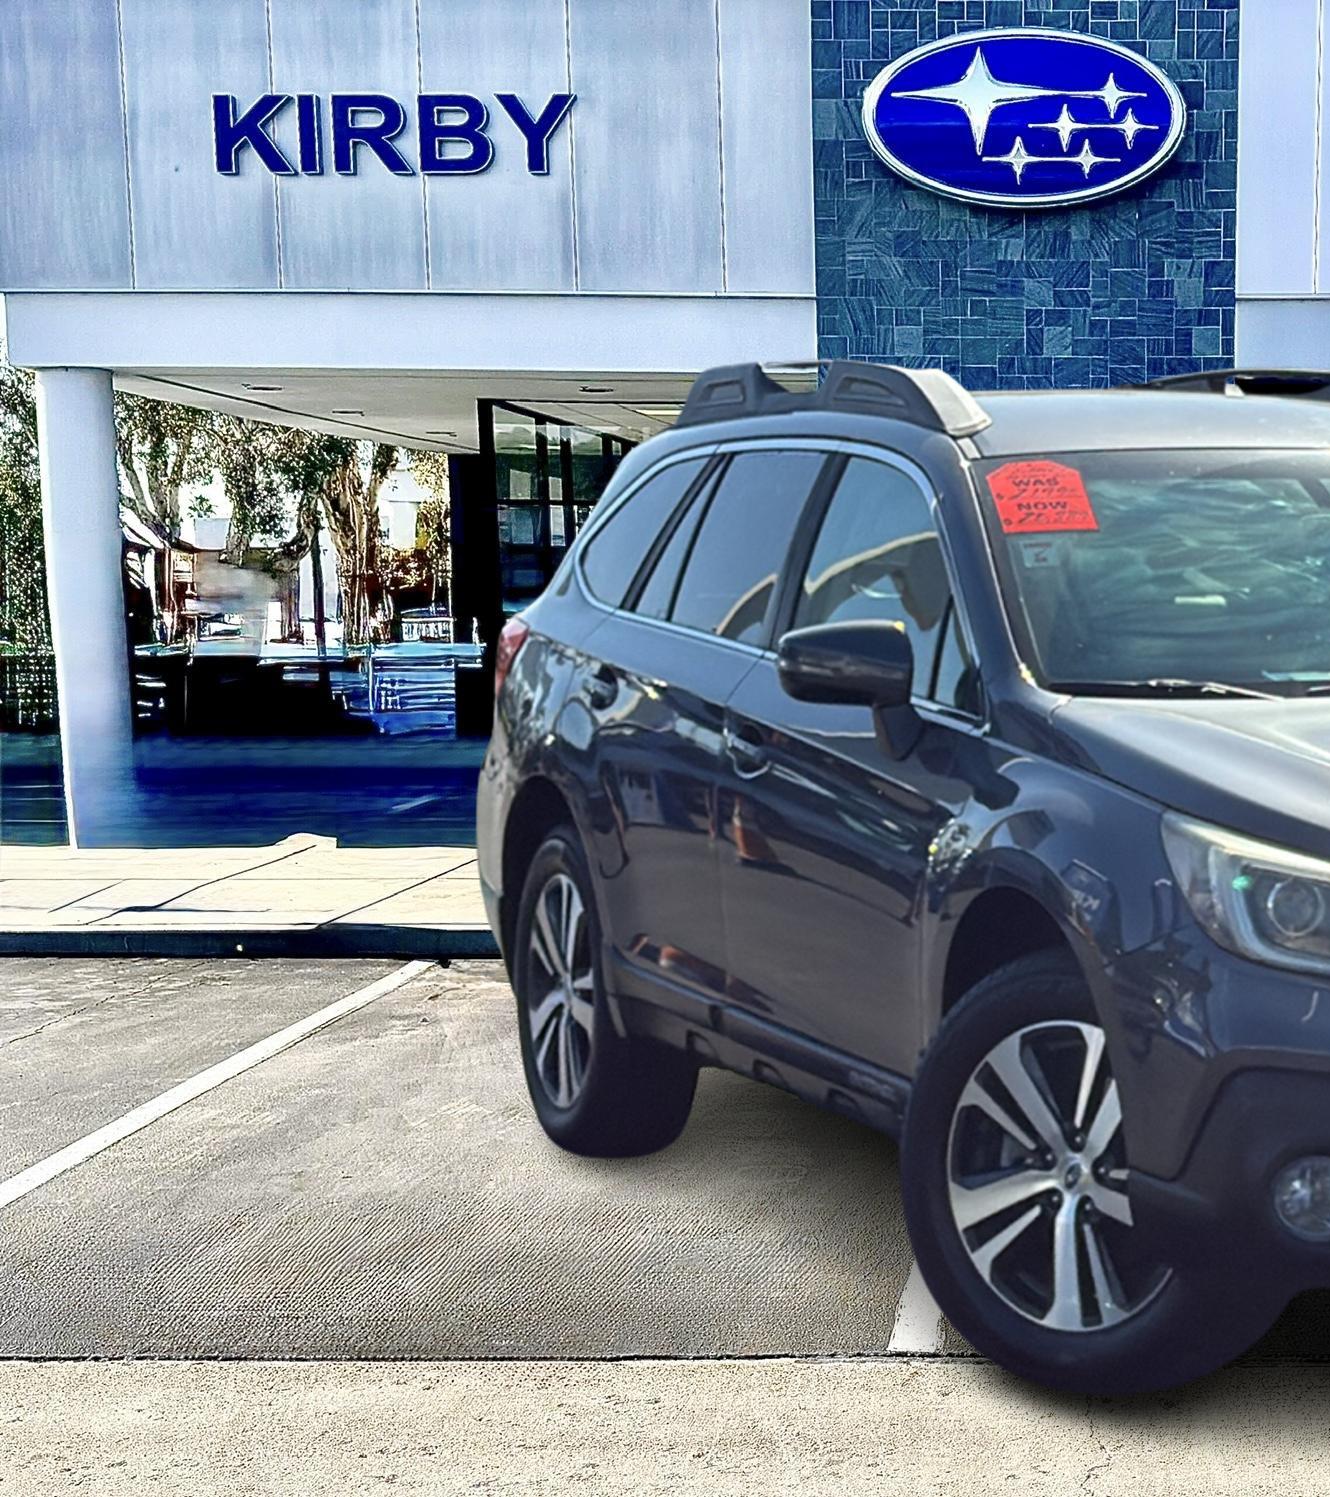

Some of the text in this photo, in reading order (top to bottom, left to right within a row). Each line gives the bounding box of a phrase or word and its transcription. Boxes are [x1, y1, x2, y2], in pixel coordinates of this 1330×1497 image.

[211, 93, 578, 175] KIRBY
[1011, 478, 1060, 487] WAS
[1017, 501, 1068, 512] NOW
